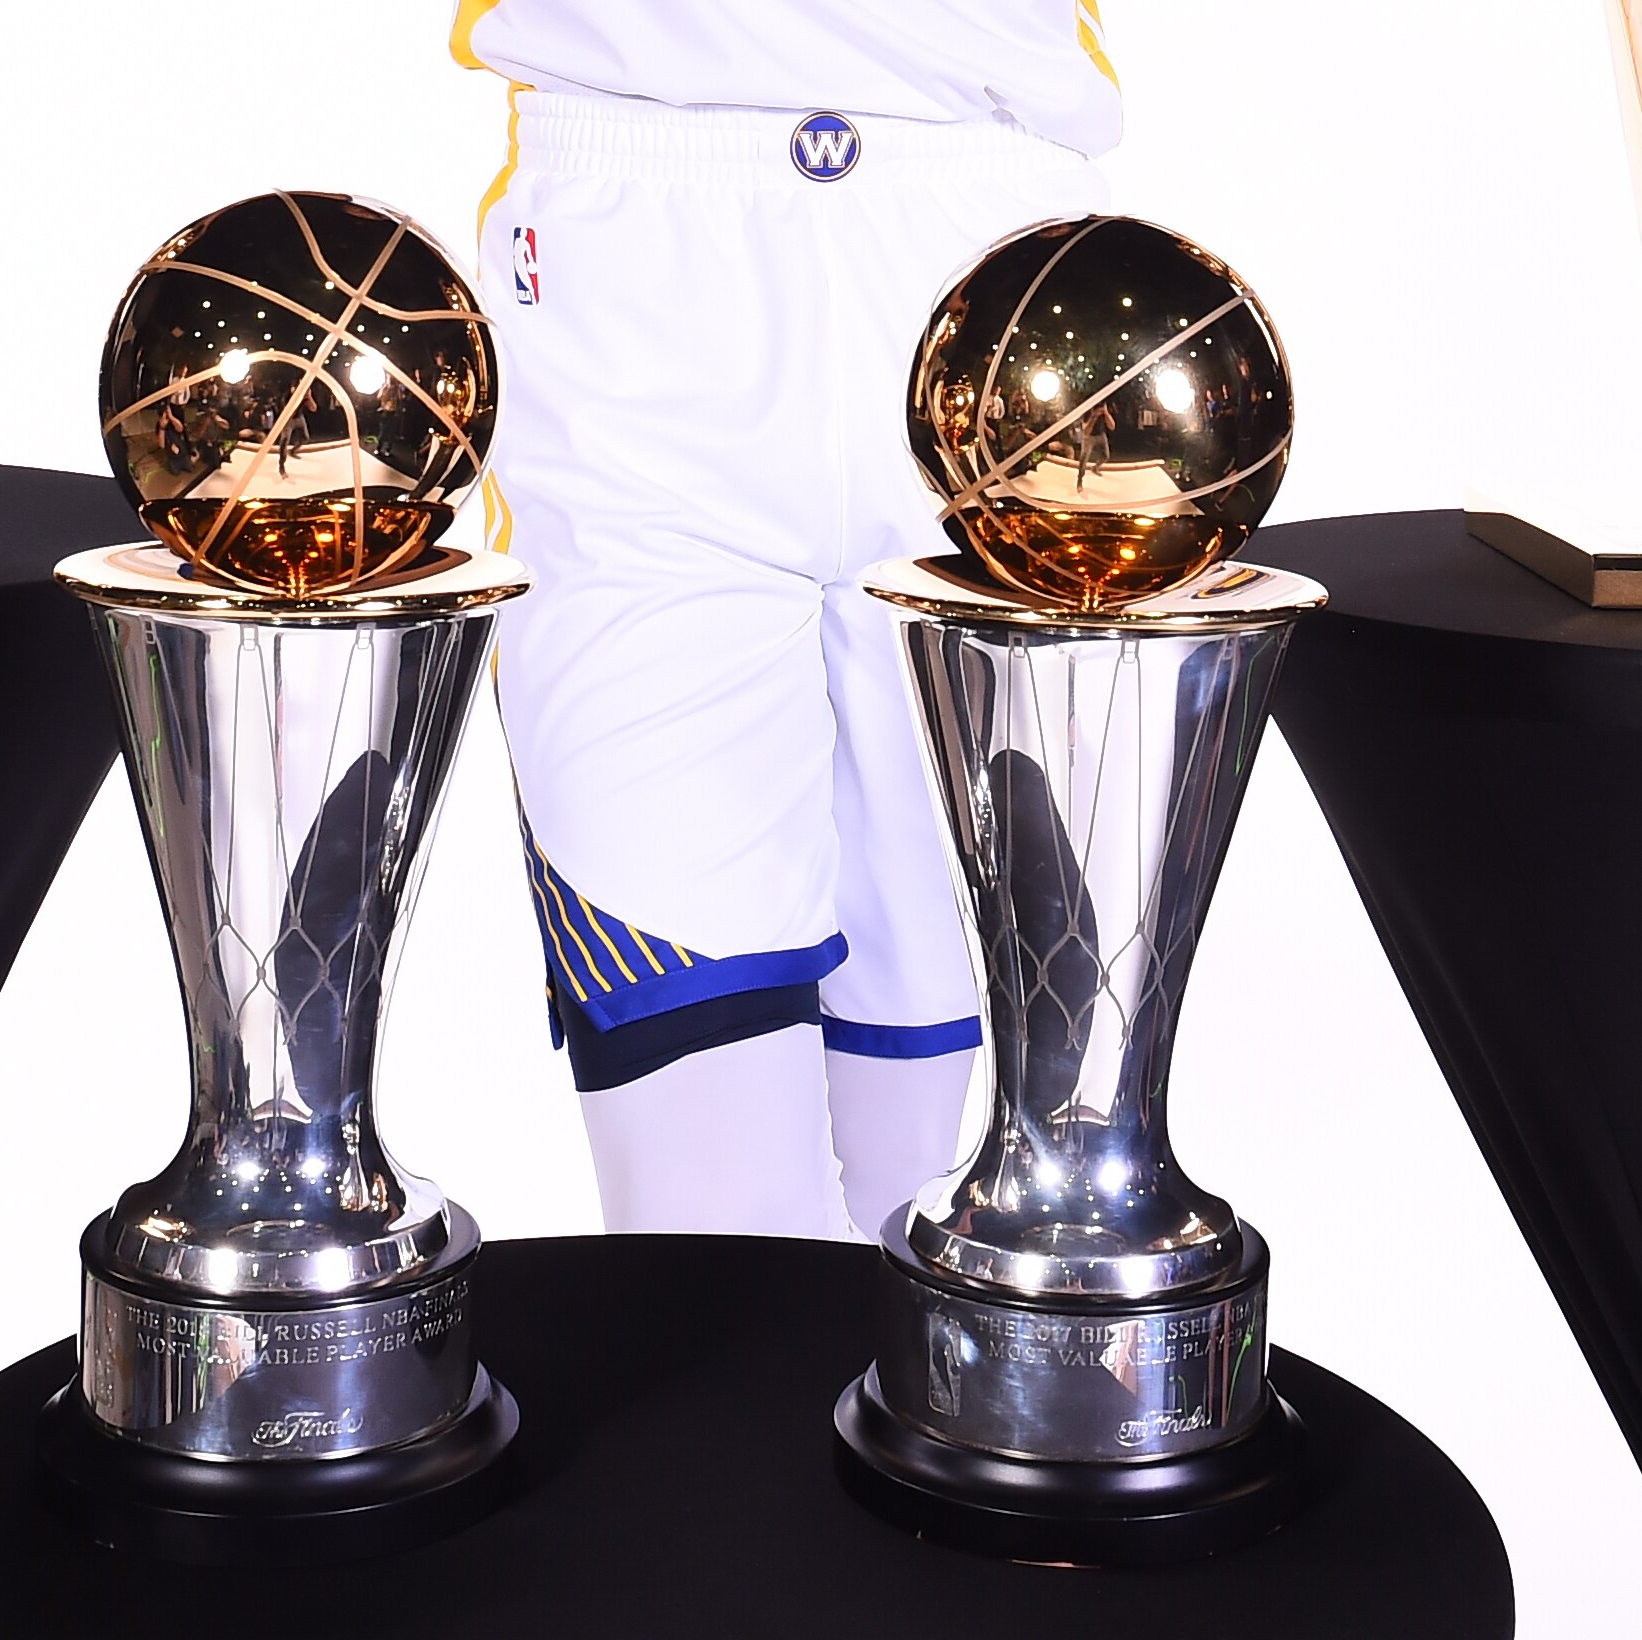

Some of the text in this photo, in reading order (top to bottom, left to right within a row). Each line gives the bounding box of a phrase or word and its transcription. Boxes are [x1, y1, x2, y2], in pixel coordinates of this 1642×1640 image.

[797, 131, 855, 168] W
[126, 1305, 160, 1330] THE
[274, 1316, 377, 1342] RUSSELL
[382, 1305, 421, 1330] NBA
[137, 1332, 191, 1359] MOST
[325, 1332, 407, 1362] PLAYER
[411, 1310, 463, 1344] AWARD
[975, 1313, 1017, 1338] THE
[1080, 1325, 1125, 1344] BILL
[1137, 1317, 1222, 1343] RSSEL
[988, 1340, 1052, 1364] MOST
[262, 1408, 364, 1446] Finals
